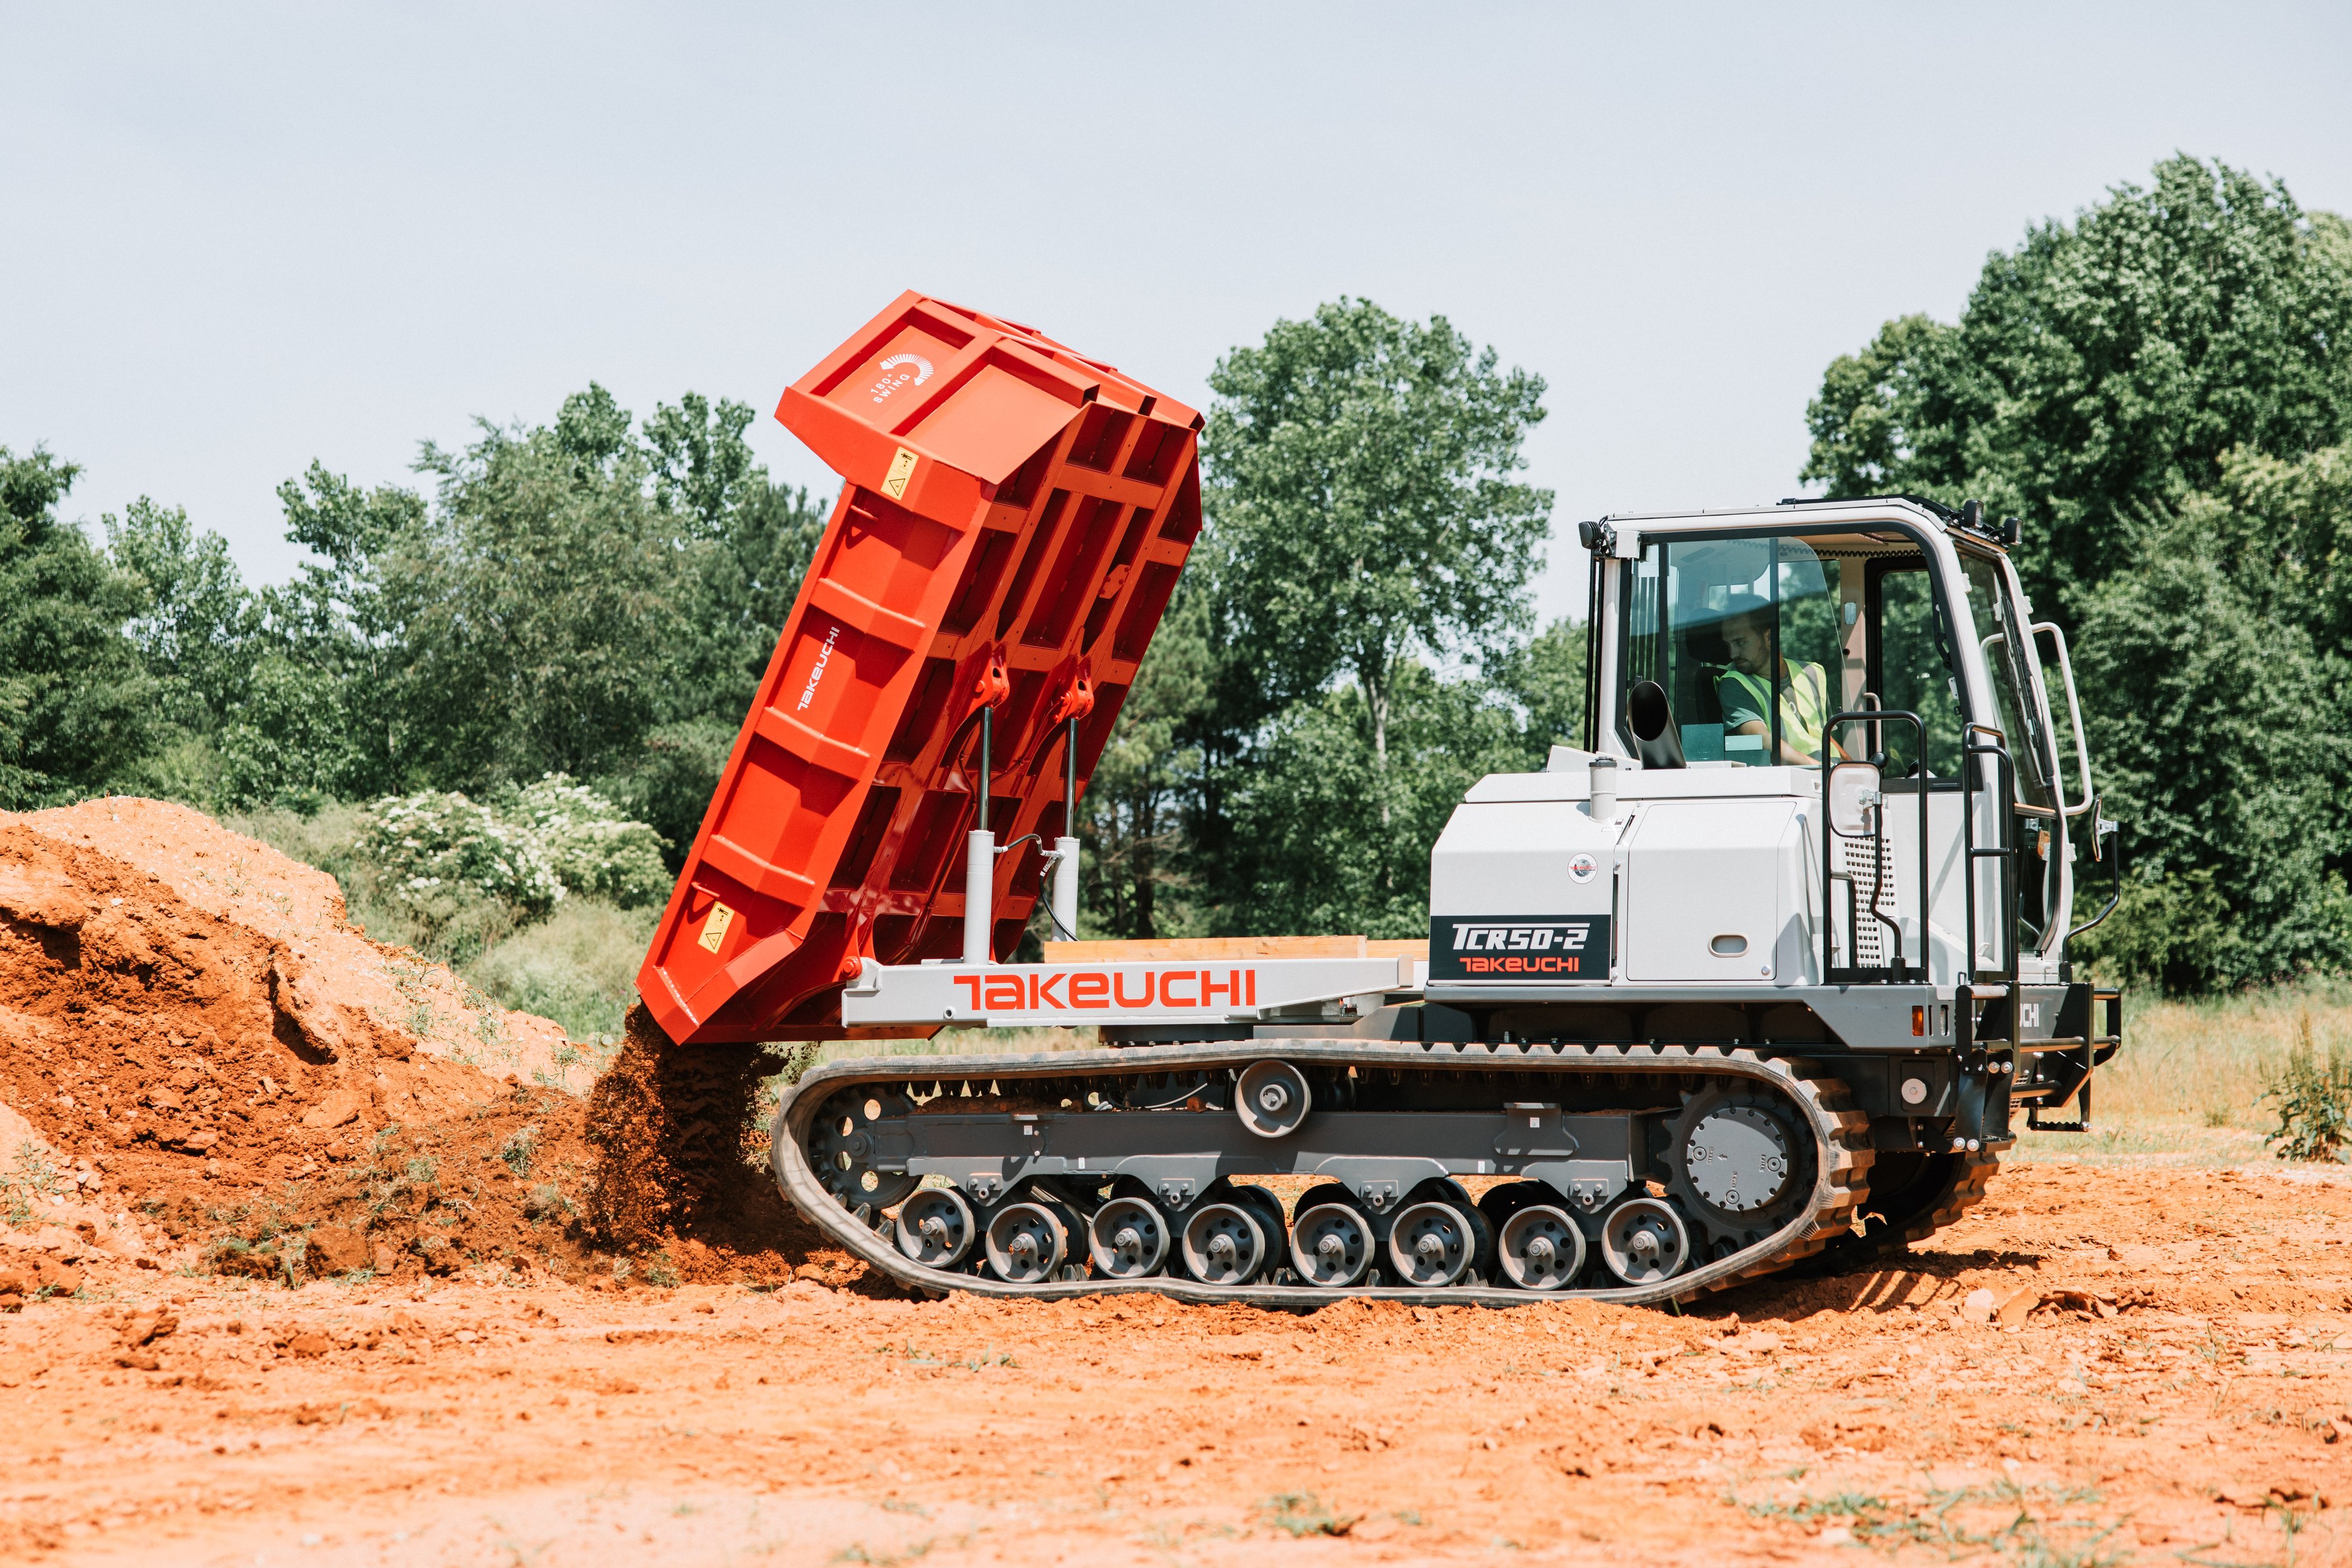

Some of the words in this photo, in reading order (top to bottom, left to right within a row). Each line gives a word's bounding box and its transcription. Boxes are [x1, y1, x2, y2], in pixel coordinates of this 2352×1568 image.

[873, 374, 911, 403] SWING
[797, 626, 840, 711] TAKEUCHI
[1452, 923, 1591, 950] TCR50-2
[1460, 957, 1579, 972] TAKEUCHI
[953, 969, 1256, 1011] TAKEUCHI
